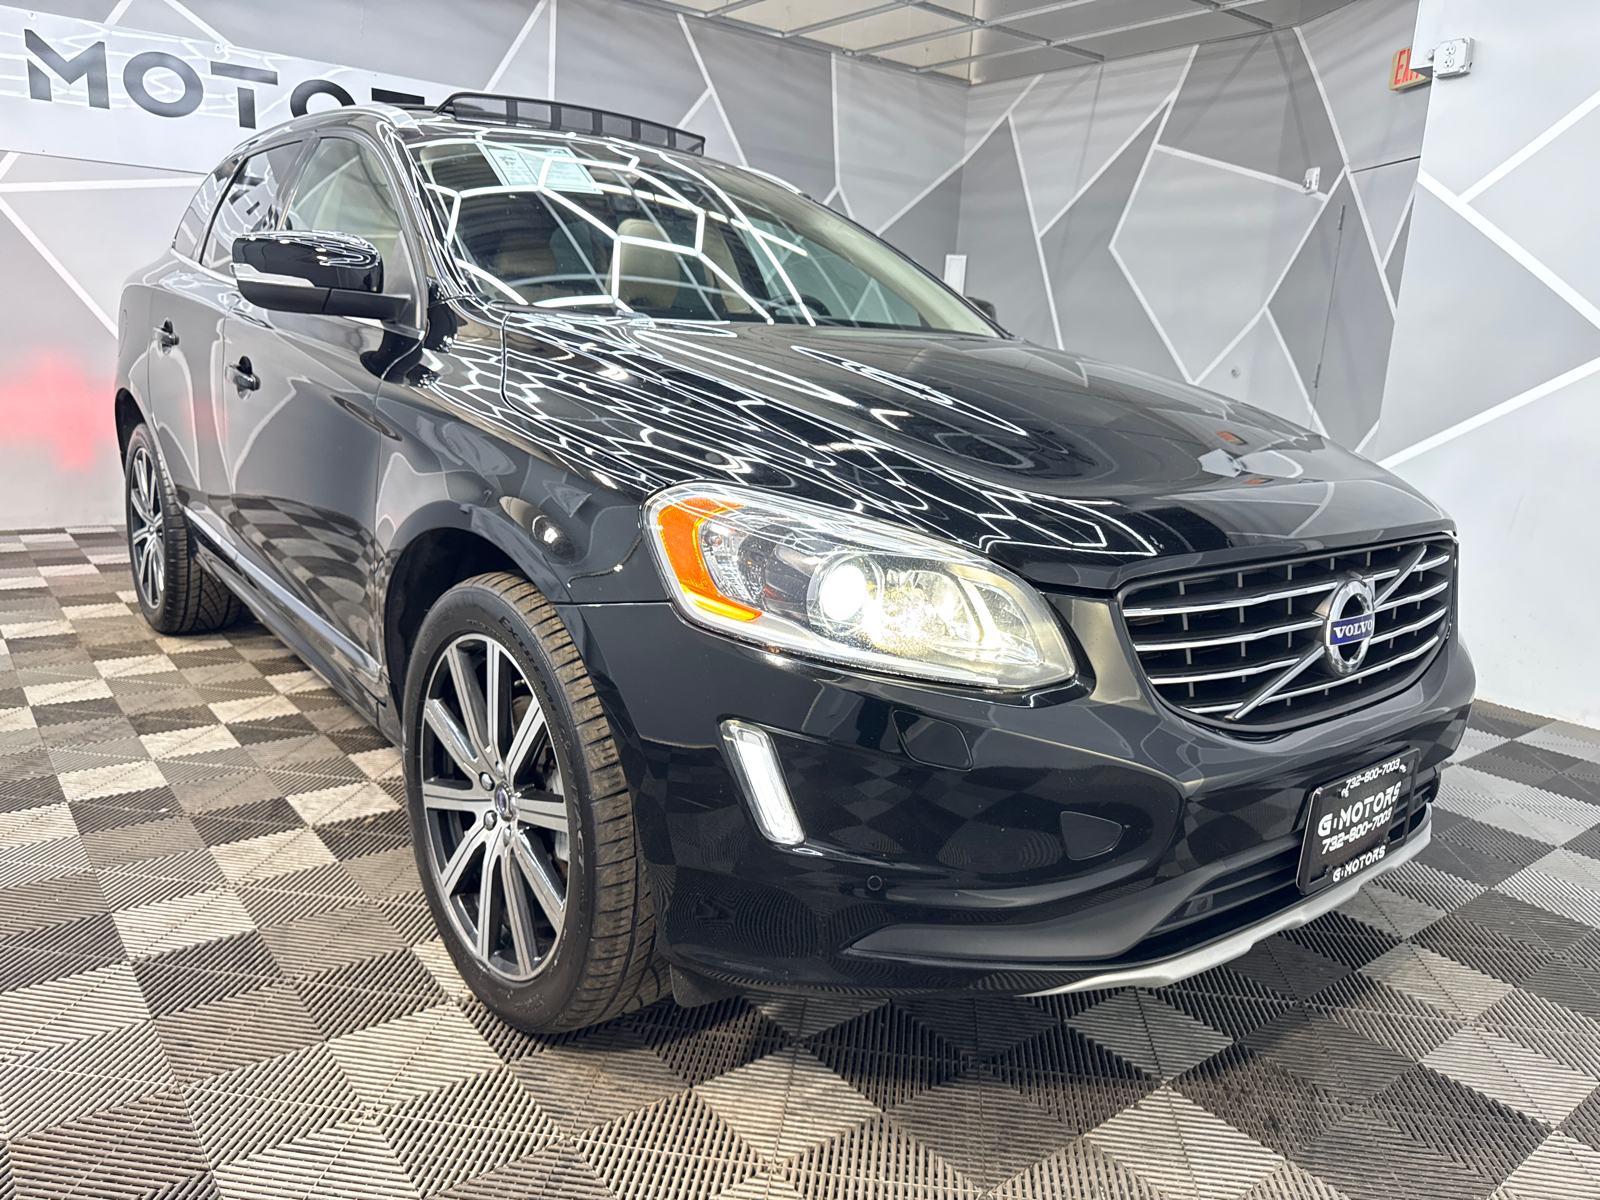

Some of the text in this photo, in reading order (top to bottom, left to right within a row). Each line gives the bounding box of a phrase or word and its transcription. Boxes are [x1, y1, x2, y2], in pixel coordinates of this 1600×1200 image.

[1333, 619, 1373, 639] VOLVO
[1345, 758, 1401, 791] 732-800-7003
[1321, 806, 1393, 855] 732-800-7003
